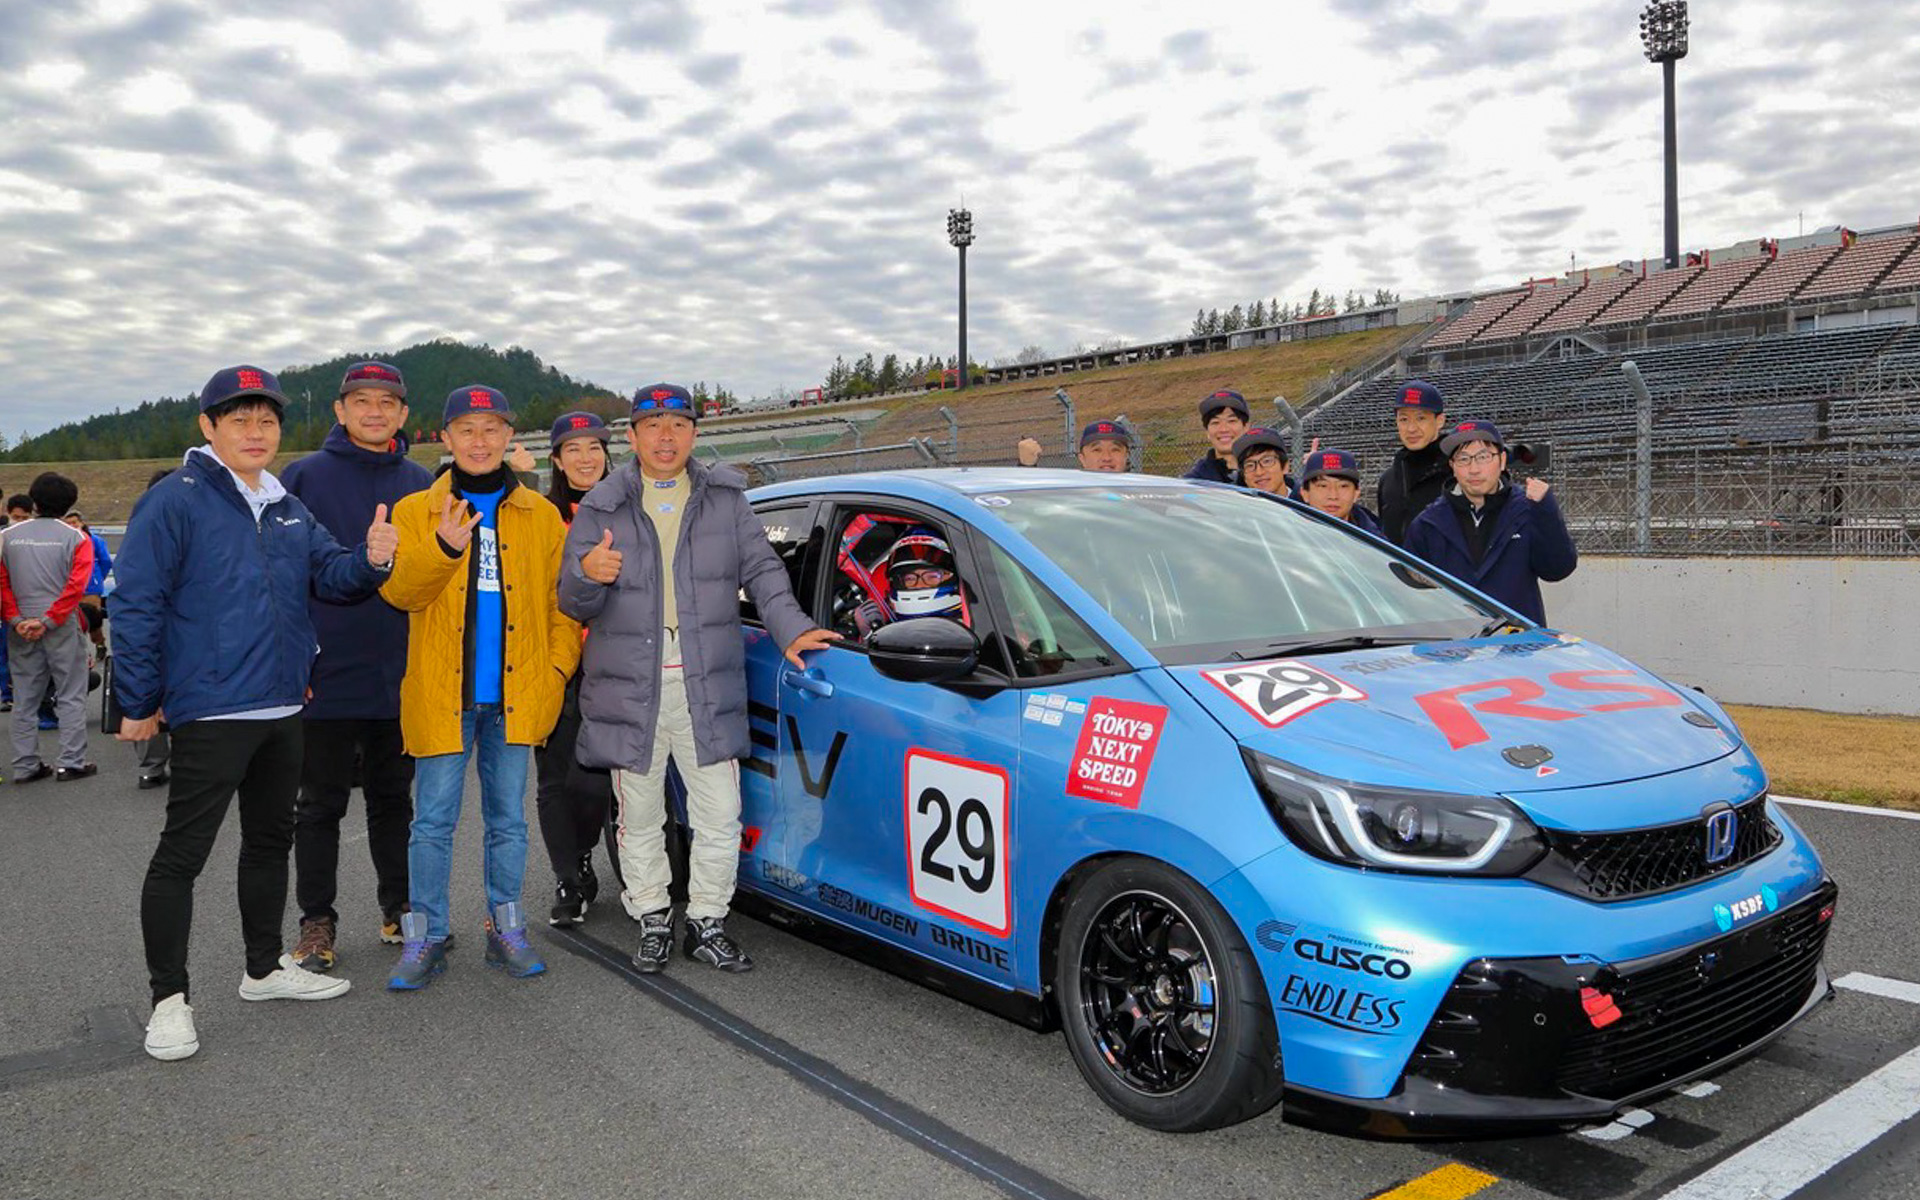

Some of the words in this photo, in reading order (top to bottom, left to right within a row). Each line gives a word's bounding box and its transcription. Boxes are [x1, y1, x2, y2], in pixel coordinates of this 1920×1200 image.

[1224, 667, 1342, 715] 29
[1413, 670, 1683, 750] RS
[1087, 736, 1142, 763] NEXT
[1092, 711, 1154, 741] TOKYO
[1078, 758, 1137, 788] SPEED
[917, 787, 995, 894] 29
[855, 899, 918, 937] MUGEN
[930, 923, 1011, 972] BRIDE
[1281, 974, 1406, 1029] ENDLESS
